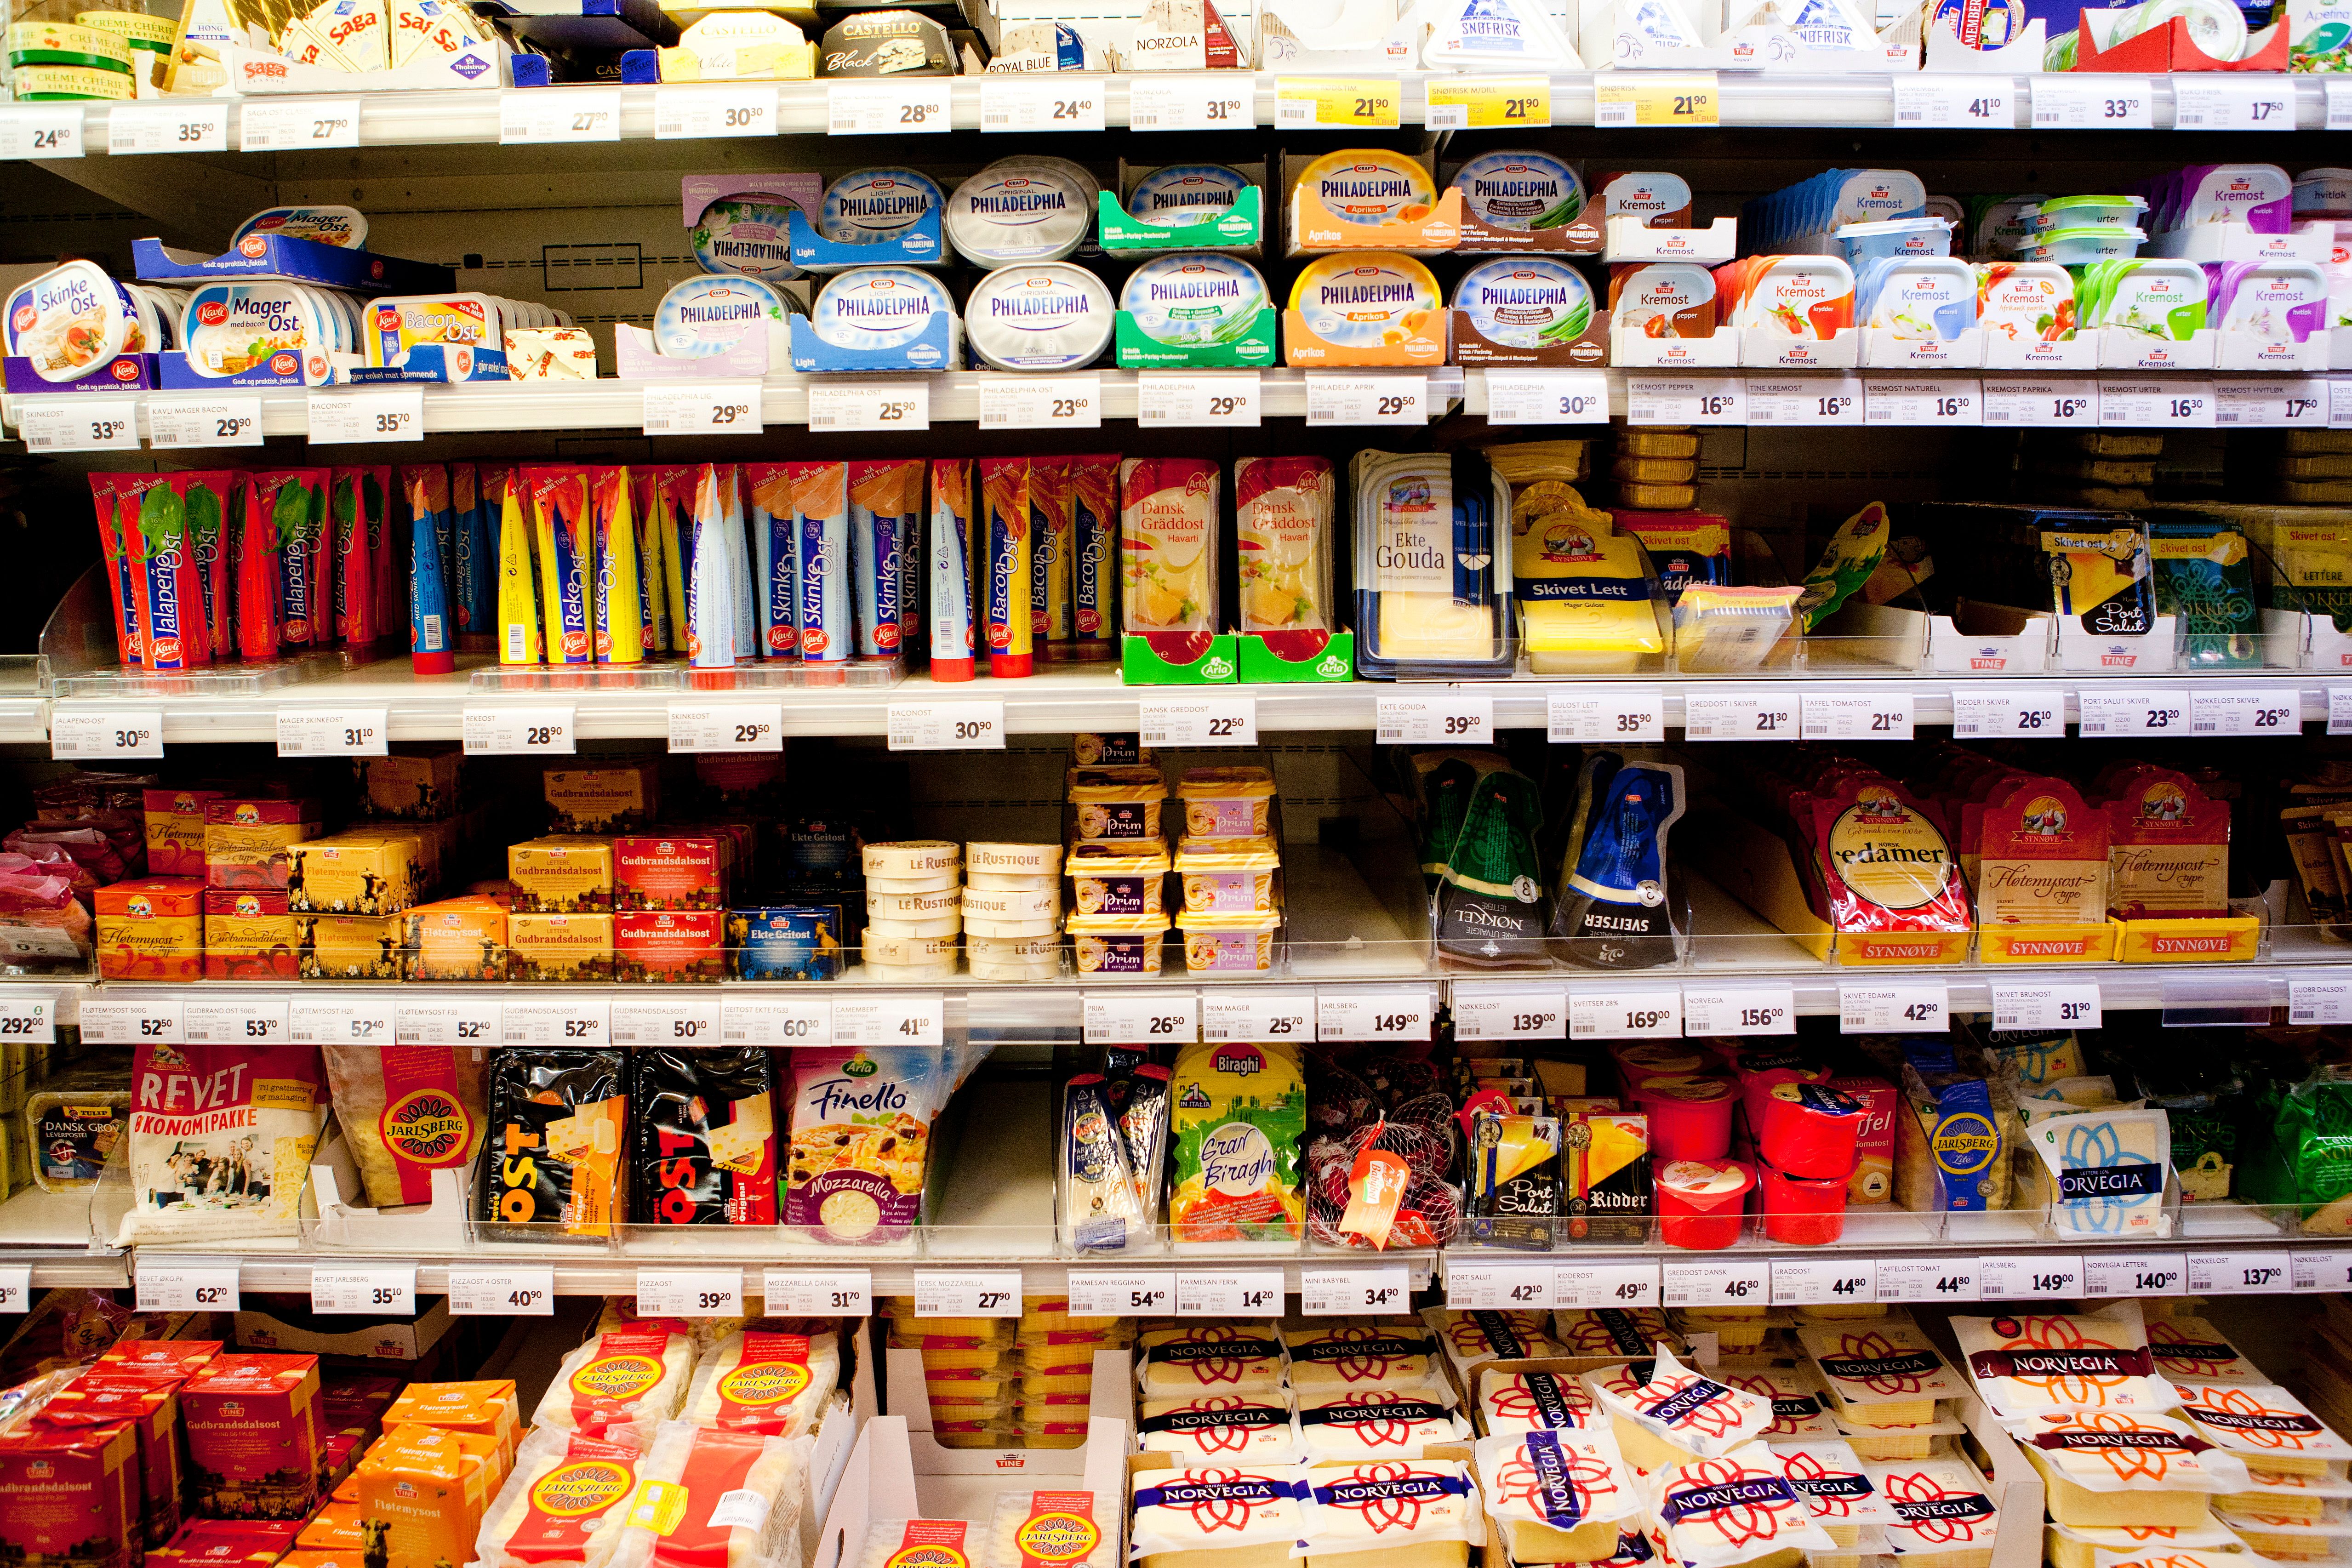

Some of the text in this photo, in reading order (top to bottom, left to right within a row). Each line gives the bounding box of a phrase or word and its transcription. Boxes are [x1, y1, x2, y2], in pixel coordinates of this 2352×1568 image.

[2305, 9, 2350, 23] Apetina
[330, 12, 377, 45] Saga
[843, 23, 920, 36] CASTELLO
[1462, 22, 1521, 37] SNØFRISK
[1137, 35, 1198, 51] NORZOLA
[826, 52, 879, 72] Black
[1026, 57, 1051, 71] BLUE
[243, 62, 287, 80] Saga
[37, 72, 123, 90] CRÈME CHÉRIE
[1322, 180, 1411, 198] PHILADELPHIA
[971, 193, 1066, 214] PHILADELPHIA
[1620, 199, 1666, 211] Kremost
[40, 280, 88, 311] Skinke
[1151, 280, 1239, 301] PHILADELPHIA
[1321, 283, 1414, 304] PHILADELPHIA
[1776, 285, 1825, 297] Kremost
[2003, 294, 2044, 303] Kremost
[2256, 291, 2304, 302] Kremost
[71, 294, 97, 316] Ost
[234, 298, 291, 317] Mager
[992, 295, 1089, 317] PHILADELPHIA
[1641, 294, 1689, 305] Kremost
[1999, 304, 2025, 313] Afrikansk
[268, 315, 299, 332] Ost
[405, 312, 454, 329] Bacon
[447, 321, 478, 341] Ost
[1293, 347, 1325, 359] Aprikos
[796, 358, 815, 367] Light
[122, 382, 141, 391] faktisk
[27, 410, 64, 418] SKINKEOST
[1142, 502, 1185, 515] Dansk
[1142, 516, 1204, 530] Gräddost
[1168, 534, 1199, 542] Havarti
[1396, 533, 1426, 548] Ekte
[2054, 537, 2102, 548] Skivet ost
[164, 530, 183, 568] Ost
[999, 535, 1018, 575] Ost
[1376, 547, 1445, 571] Gouda
[573, 550, 590, 591] Ost
[150, 554, 179, 635] Jalapeño
[804, 566, 824, 625] Skinke
[991, 557, 1011, 620] Bacon
[1533, 583, 1627, 597] Skivet Lett
[565, 574, 583, 628] Reke
[2095, 617, 2144, 633] Salut
[1205, 662, 1228, 675] Arla
[2103, 656, 2133, 666] TINE
[622, 856, 710, 867] Gudbrandsdalsost
[973, 852, 1040, 867] LE RUSTIQUE
[1836, 842, 1943, 865] edamer
[307, 866, 359, 878] Fløtemysost
[515, 866, 602, 877] Gudbrandsdalsost
[1112, 904, 1137, 913] original
[1585, 914, 1649, 932] SVEITSER
[751, 929, 811, 940] Ekte Geitost
[1866, 946, 1939, 957] SYNNØVE
[1218, 1056, 1259, 1073] Biraghi
[140, 1062, 248, 1111] REVET
[808, 1078, 908, 1120] Finello
[46, 1122, 120, 1133] DANSK GROV
[134, 1108, 257, 1137] ØKONOMIPAKKE
[387, 1118, 463, 1139] JARLSBERG
[1935, 1138, 1995, 1150] JARLSBERG
[1952, 1154, 1970, 1164] Lite
[1204, 1152, 1278, 1189] Biraghi
[808, 1175, 891, 1202] Mozzarella
[1590, 1191, 1647, 1209] Ridder
[1835, 1359, 1926, 1374] NORVEGIA
[2014, 1357, 2118, 1373] NORVEGIA
[576, 1371, 655, 1383] JARLSBERG
[1329, 1406, 1427, 1421] NORVEGIA
[188, 1420, 280, 1430] Gudbrandsdalsost
[1540, 1445, 1570, 1509] NORVEGIA
[1165, 1485, 1271, 1501] NORVEGIA
[1676, 1483, 1780, 1509] NORVEGIA
[375, 1500, 441, 1519] Fløtemysost
[1022, 1532, 1092, 1543] JARLSBERG
